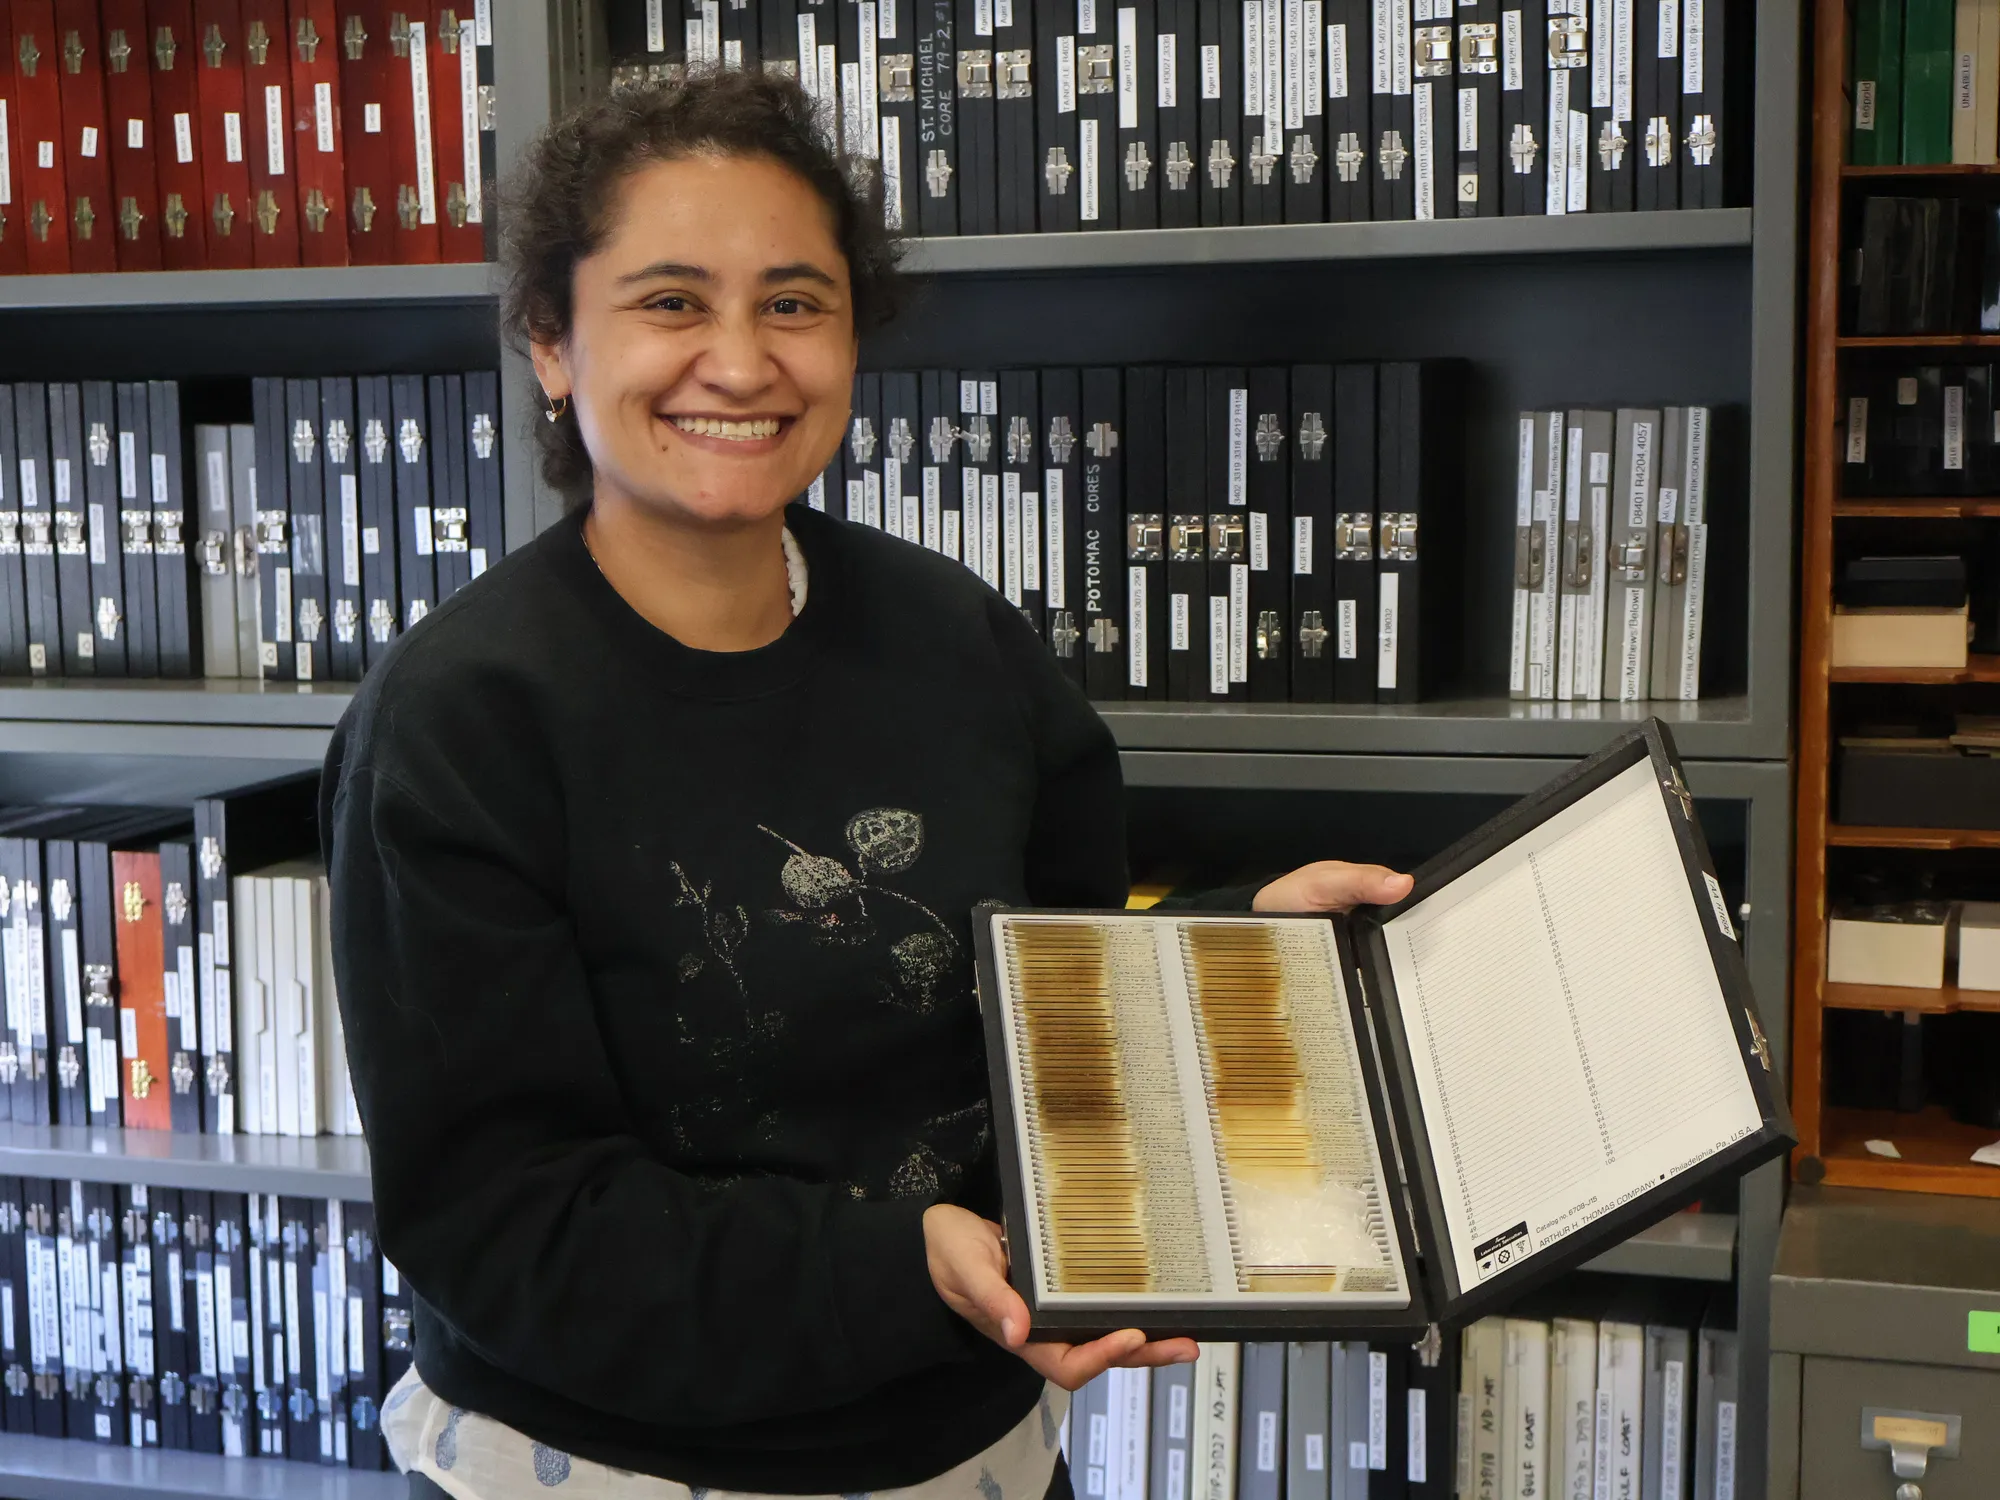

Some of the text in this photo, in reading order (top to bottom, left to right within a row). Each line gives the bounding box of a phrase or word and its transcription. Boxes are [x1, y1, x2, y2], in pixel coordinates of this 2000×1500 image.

[1664, 4, 1673, 23] Ager
[1123, 45, 1132, 92] Ager R2134
[1378, 69, 1387, 89] Ager
[1508, 66, 1518, 87] Ager
[919, 32, 935, 142] ST. MICHAEL
[1163, 86, 1172, 106] Ager
[1207, 76, 1216, 95] Ager
[1334, 77, 1343, 96] Ager
[938, 90, 952, 135] CORE
[964, 383, 973, 411] CRAIG
[1633, 491, 1645, 525] D8401
[1086, 464, 1102, 612] POTOMAC CORES
[1255, 543, 1264, 568] AGER
[1299, 547, 1308, 571] AGER
[1176, 623, 1185, 647] AGER
[1343, 630, 1352, 655] AGER
[1134, 659, 1143, 684] AGER
[1539, 1226, 1571, 1248] ARTHUR
[1581, 1202, 1616, 1224] THOMAS
[1616, 1178, 1657, 1206] COMPANY
[1669, 1148, 1715, 1176] Philadelphia,
[1730, 1126, 1754, 1142] U.S.A.
[1522, 1406, 1535, 1450] COAST
